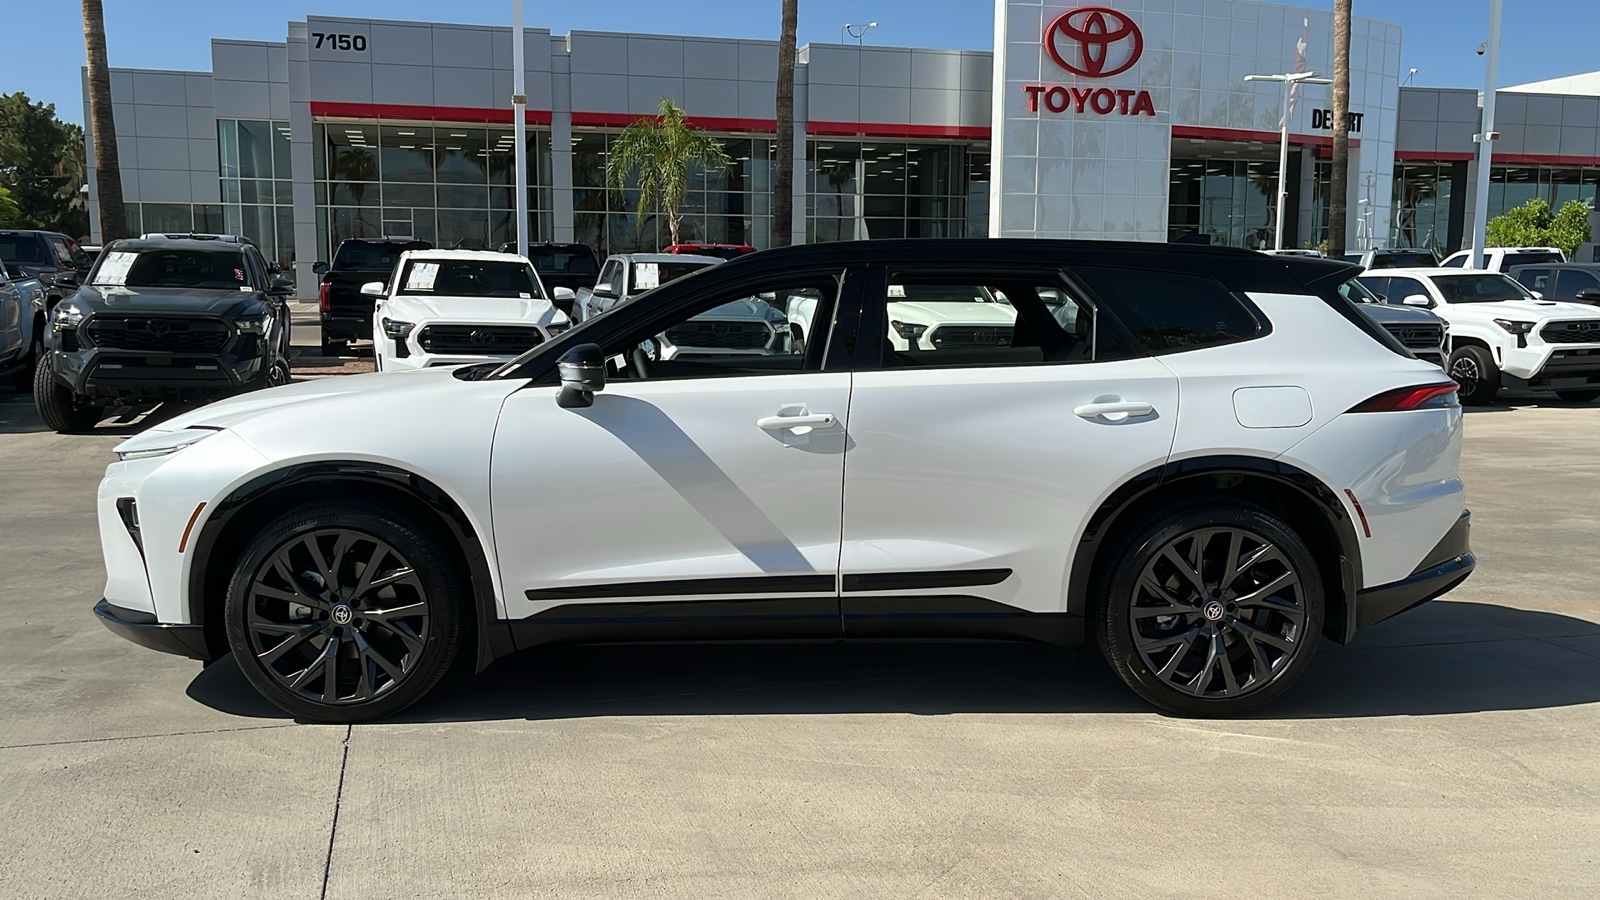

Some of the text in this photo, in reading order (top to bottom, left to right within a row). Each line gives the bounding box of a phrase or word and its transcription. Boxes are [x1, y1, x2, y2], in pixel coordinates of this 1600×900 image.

[312, 33, 366, 51] 7150
[1023, 86, 1156, 116] TOYOTA
[1312, 109, 1364, 132] DERT
